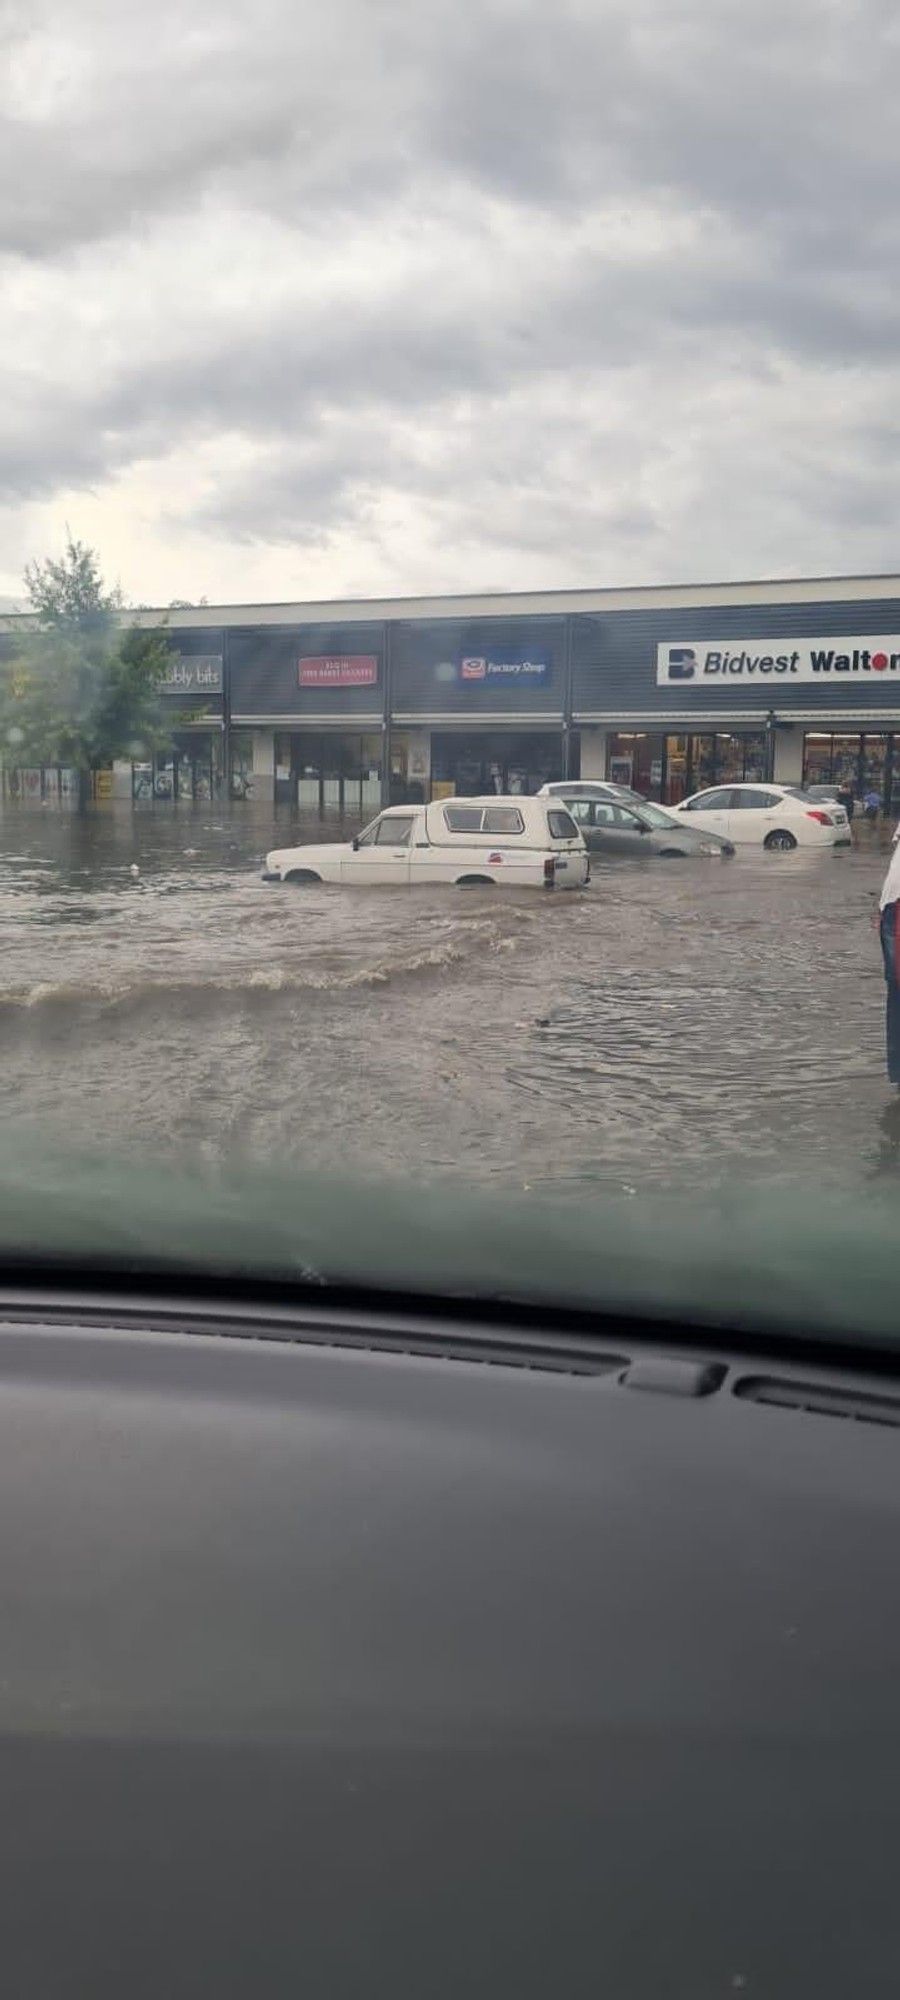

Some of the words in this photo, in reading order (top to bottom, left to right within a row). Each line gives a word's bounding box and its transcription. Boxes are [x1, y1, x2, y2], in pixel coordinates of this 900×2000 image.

[487, 662, 521, 675] Factory
[522, 661, 546, 674] Shop
[704, 651, 800, 674] Bidvest
[810, 649, 900, 671] Walton
[197, 664, 220, 685] bits
